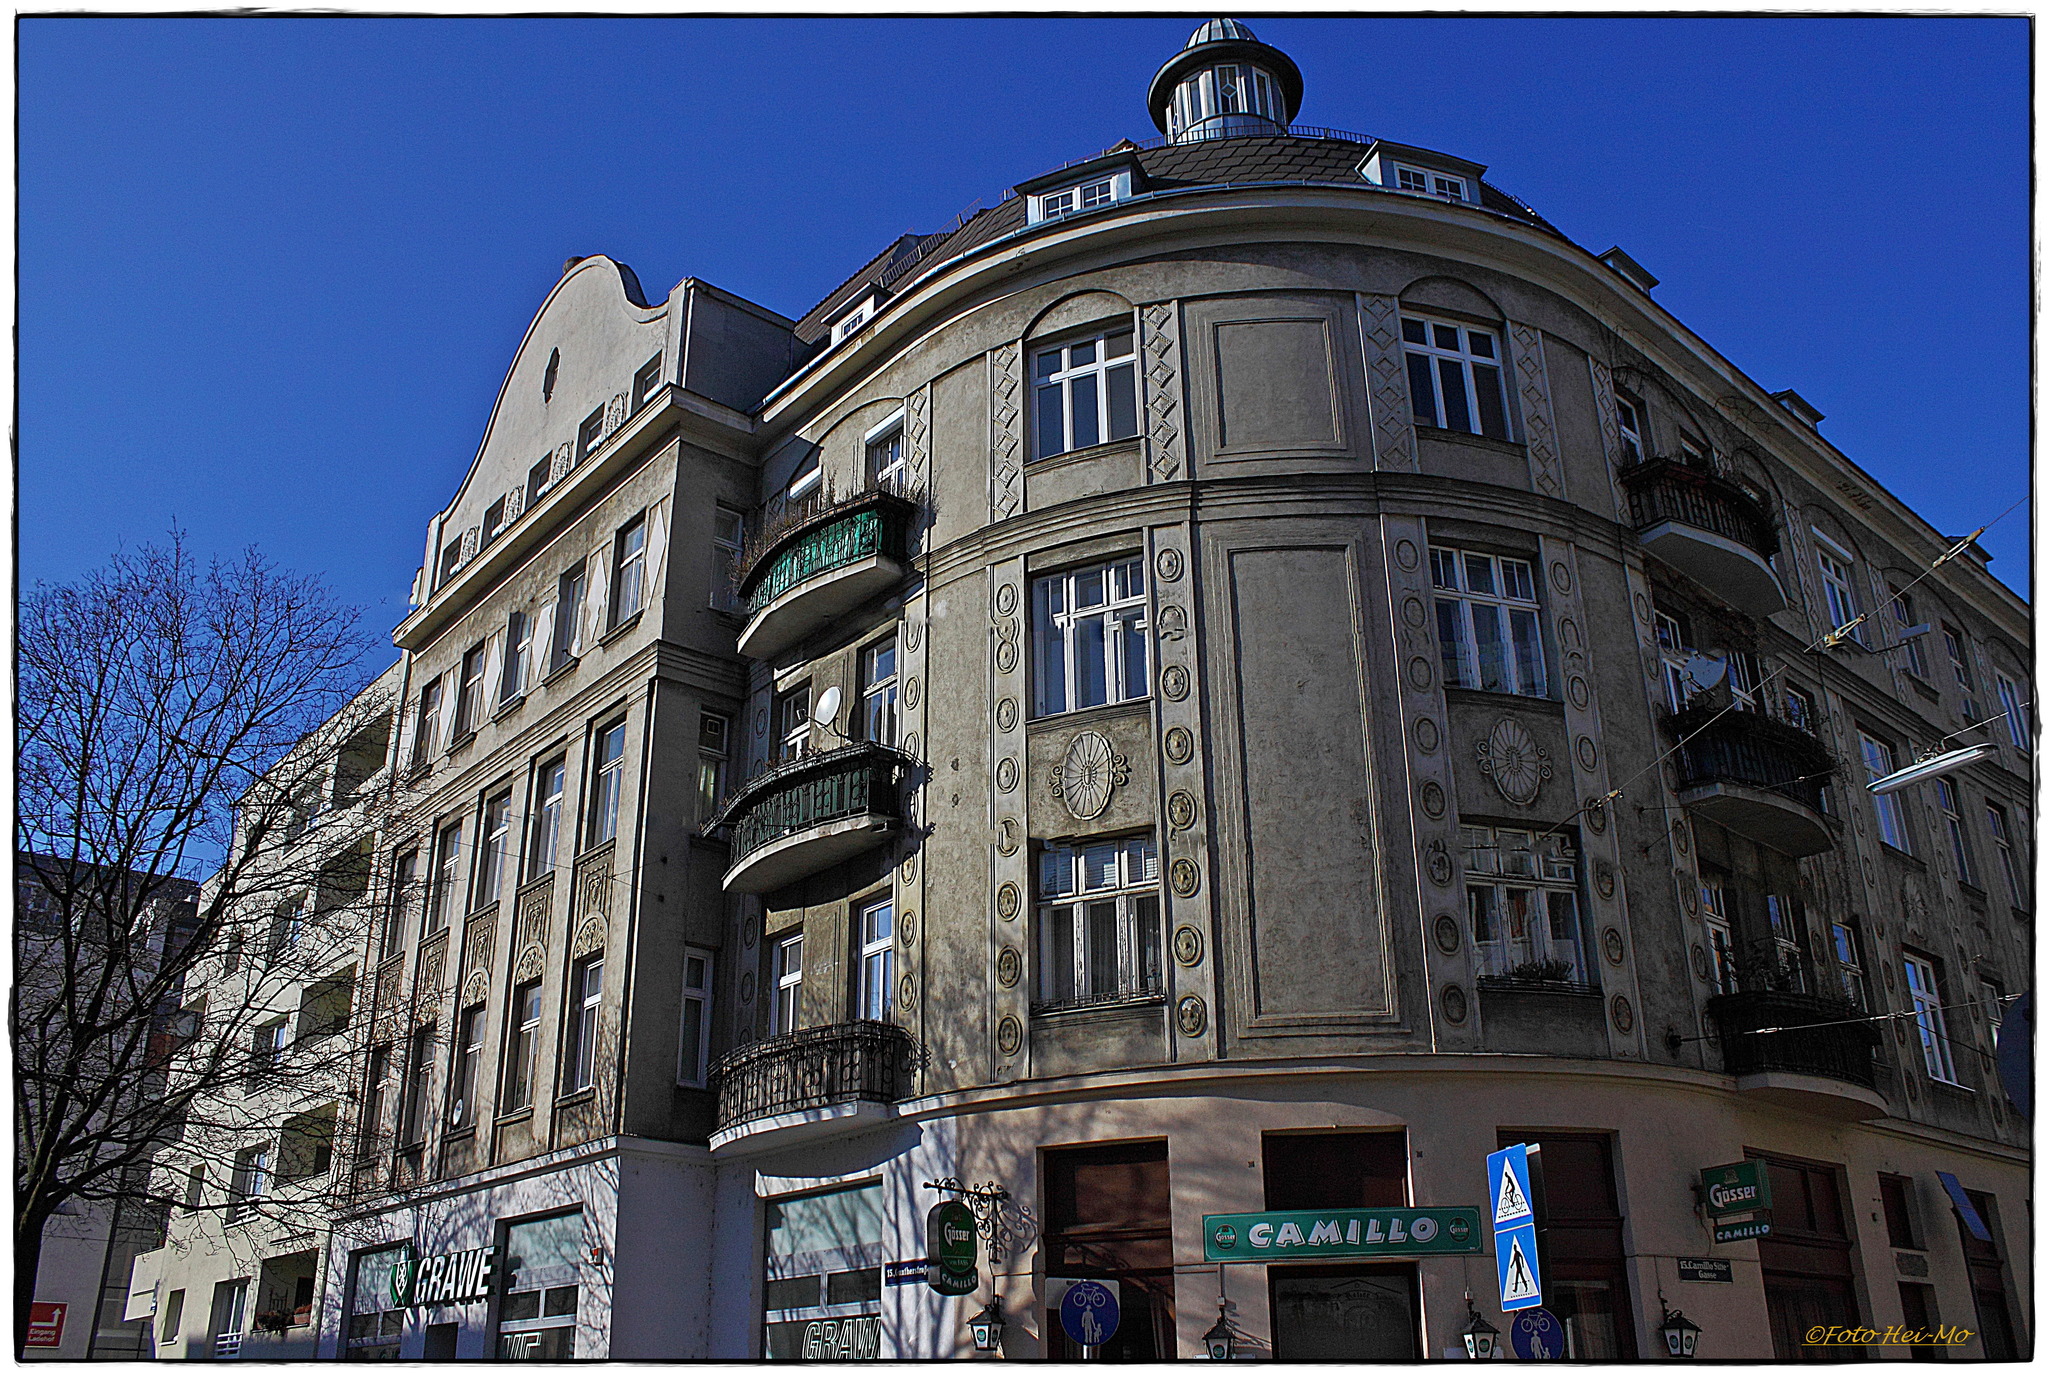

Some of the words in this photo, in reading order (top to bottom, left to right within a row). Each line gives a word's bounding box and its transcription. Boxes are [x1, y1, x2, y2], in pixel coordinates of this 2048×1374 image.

[1710, 1183, 1756, 1208] Gösser
[943, 1221, 970, 1247] Gösser
[1249, 1217, 1439, 1248] CAMILLO
[1716, 1224, 1770, 1240] CAMILLO
[414, 1246, 495, 1304] GRAWE
[941, 1273, 977, 1289] CAMILLO
